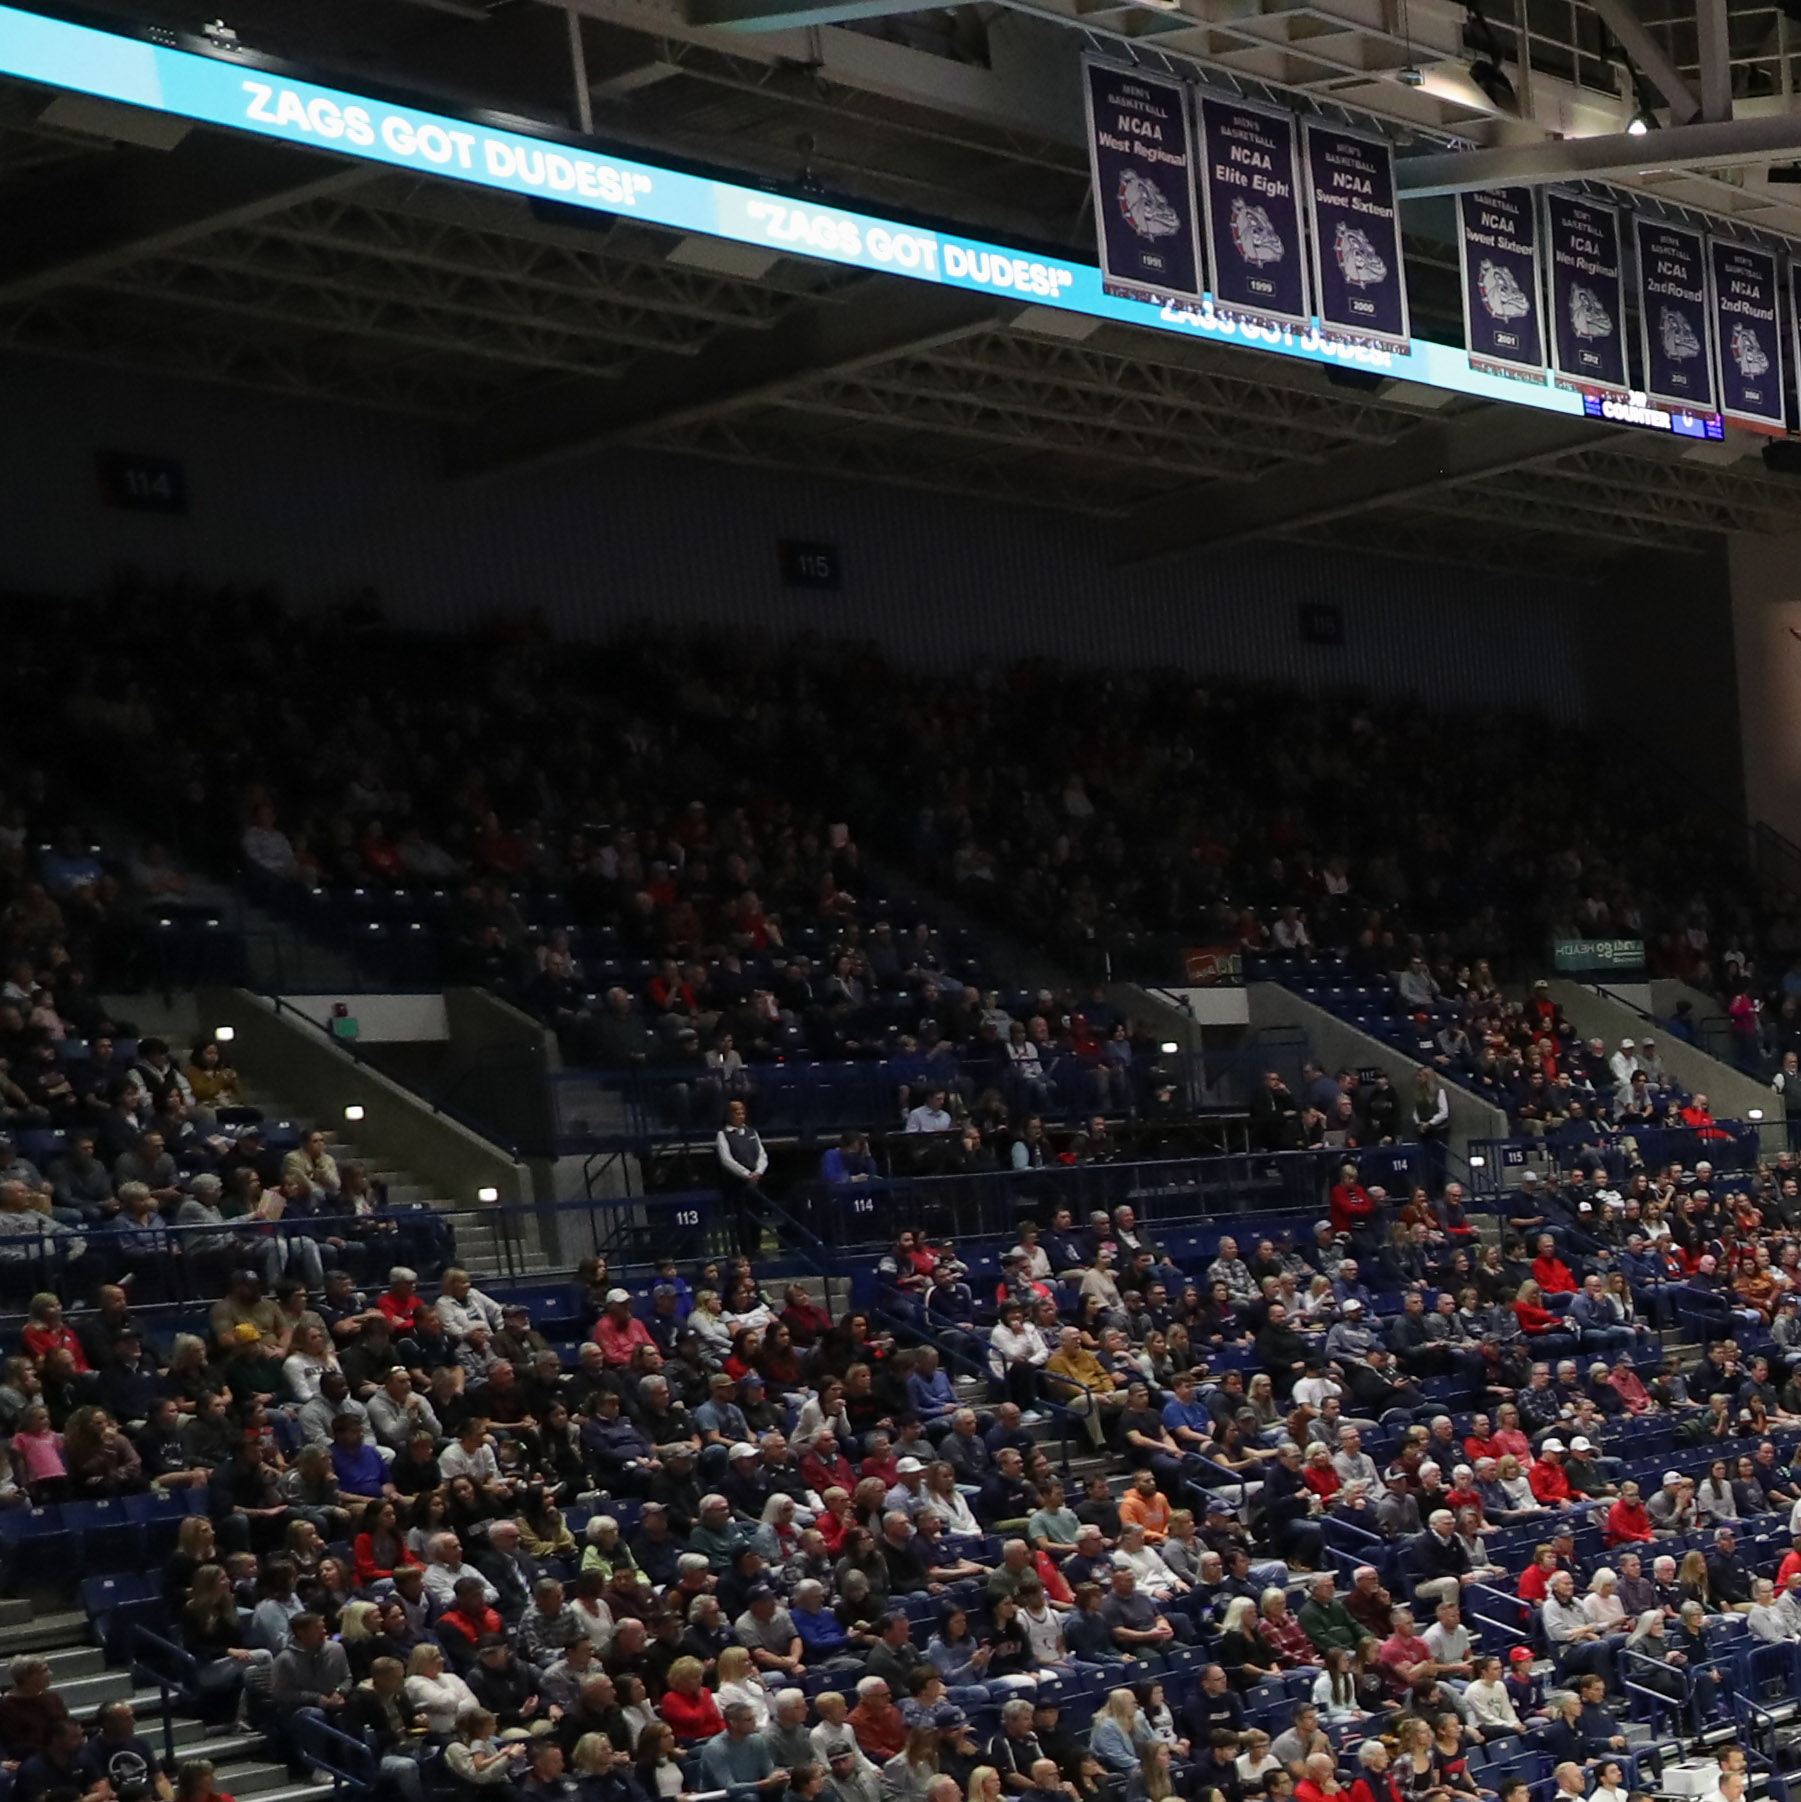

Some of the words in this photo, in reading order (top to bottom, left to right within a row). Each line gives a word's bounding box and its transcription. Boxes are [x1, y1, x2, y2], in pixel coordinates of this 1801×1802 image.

[242, 81, 376, 147] ZAGS
[381, 115, 477, 169] GOT
[1117, 114, 1163, 142] NCAA
[1098, 130, 1132, 155] West
[1132, 141, 1188, 169] Regional
[1229, 144, 1274, 172] NCAA
[1214, 163, 1250, 189] Elite
[1251, 172, 1291, 200] Eight
[1331, 170, 1374, 195] NCAA
[1314, 187, 1350, 209] Sweet
[1351, 195, 1395, 219] Sixteen
[1480, 211, 1517, 236] NCAA
[865, 227, 940, 272] GOT
[1657, 260, 1689, 282] NCAA
[1249, 278, 1274, 294] 1999
[1647, 277, 1668, 296] 2nd
[1667, 279, 1703, 303] Round
[1730, 280, 1762, 300] NCAA
[1351, 300, 1376, 314] 2000
[1720, 296, 1744, 315] 2nd
[1496, 333, 1518, 347] 2001
[800, 555, 829, 578] 115
[1392, 1159, 1409, 1172] 114
[1508, 1152, 1524, 1164] 115
[853, 1198, 875, 1213] 114
[676, 1210, 700, 1226] 113
